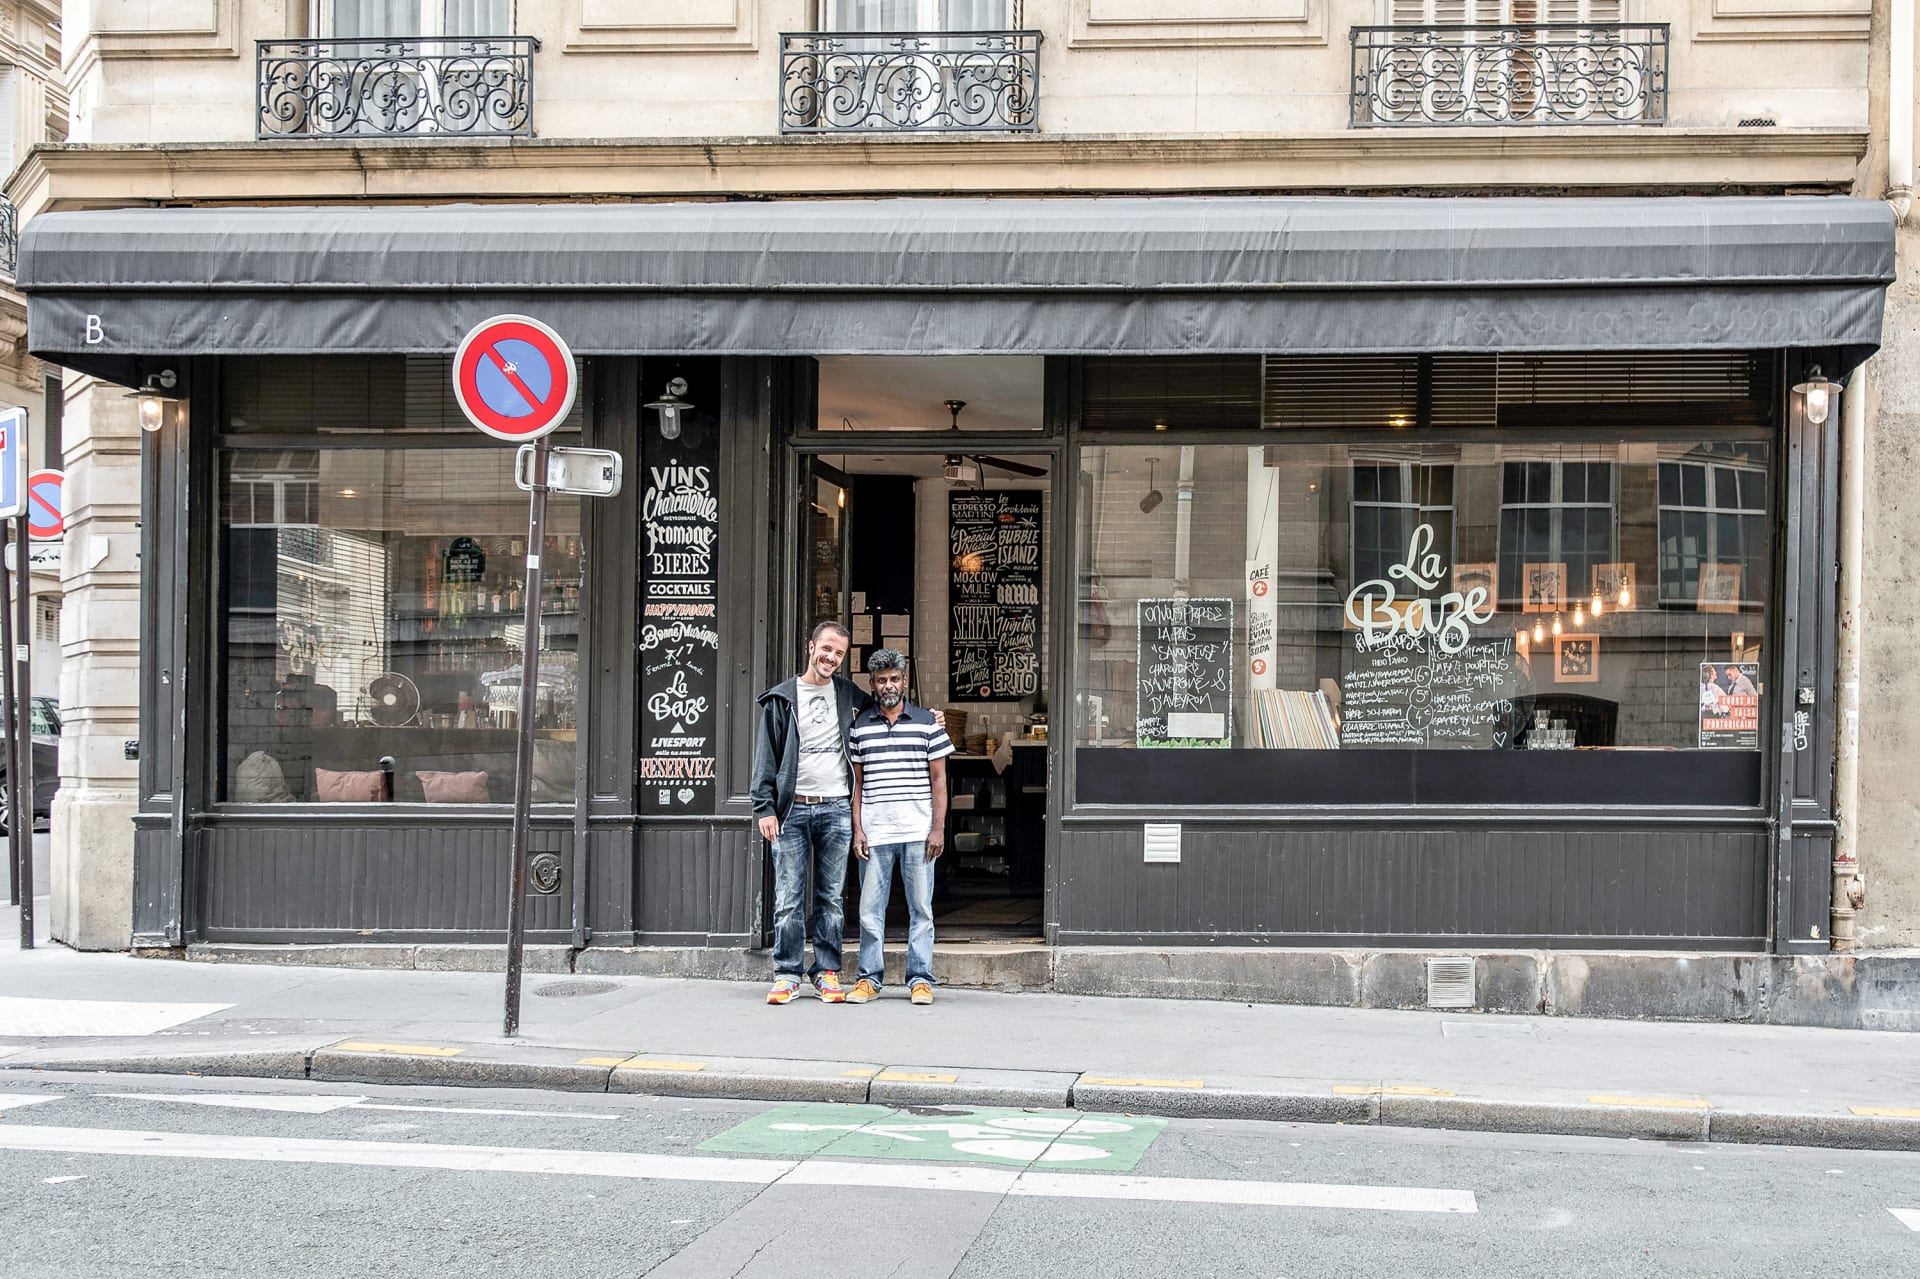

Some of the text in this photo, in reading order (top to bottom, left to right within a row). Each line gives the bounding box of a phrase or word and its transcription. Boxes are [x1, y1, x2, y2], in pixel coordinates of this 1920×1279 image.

[86, 315, 104, 344] B
[951, 503, 996, 511] EXPRESSO
[952, 511, 994, 519] MARTINI
[998, 530, 1040, 546] BUBBLE
[652, 553, 711, 575] BIERES
[1387, 523, 1447, 590] La
[1250, 564, 1269, 580] CAFÉ
[649, 584, 711, 595] COCKTAILS
[962, 584, 990, 594] MULE
[997, 583, 1039, 605] BAHIA
[1345, 579, 1494, 653] Baze
[1158, 626, 1196, 645] LA PLUS
[1250, 643, 1270, 656] SODA
[666, 670, 688, 699] La
[648, 692, 709, 724] Baze
[1722, 696, 1744, 705] COURS
[1734, 708, 1756, 717] SALSA
[640, 757, 715, 778] RESERVEZ
